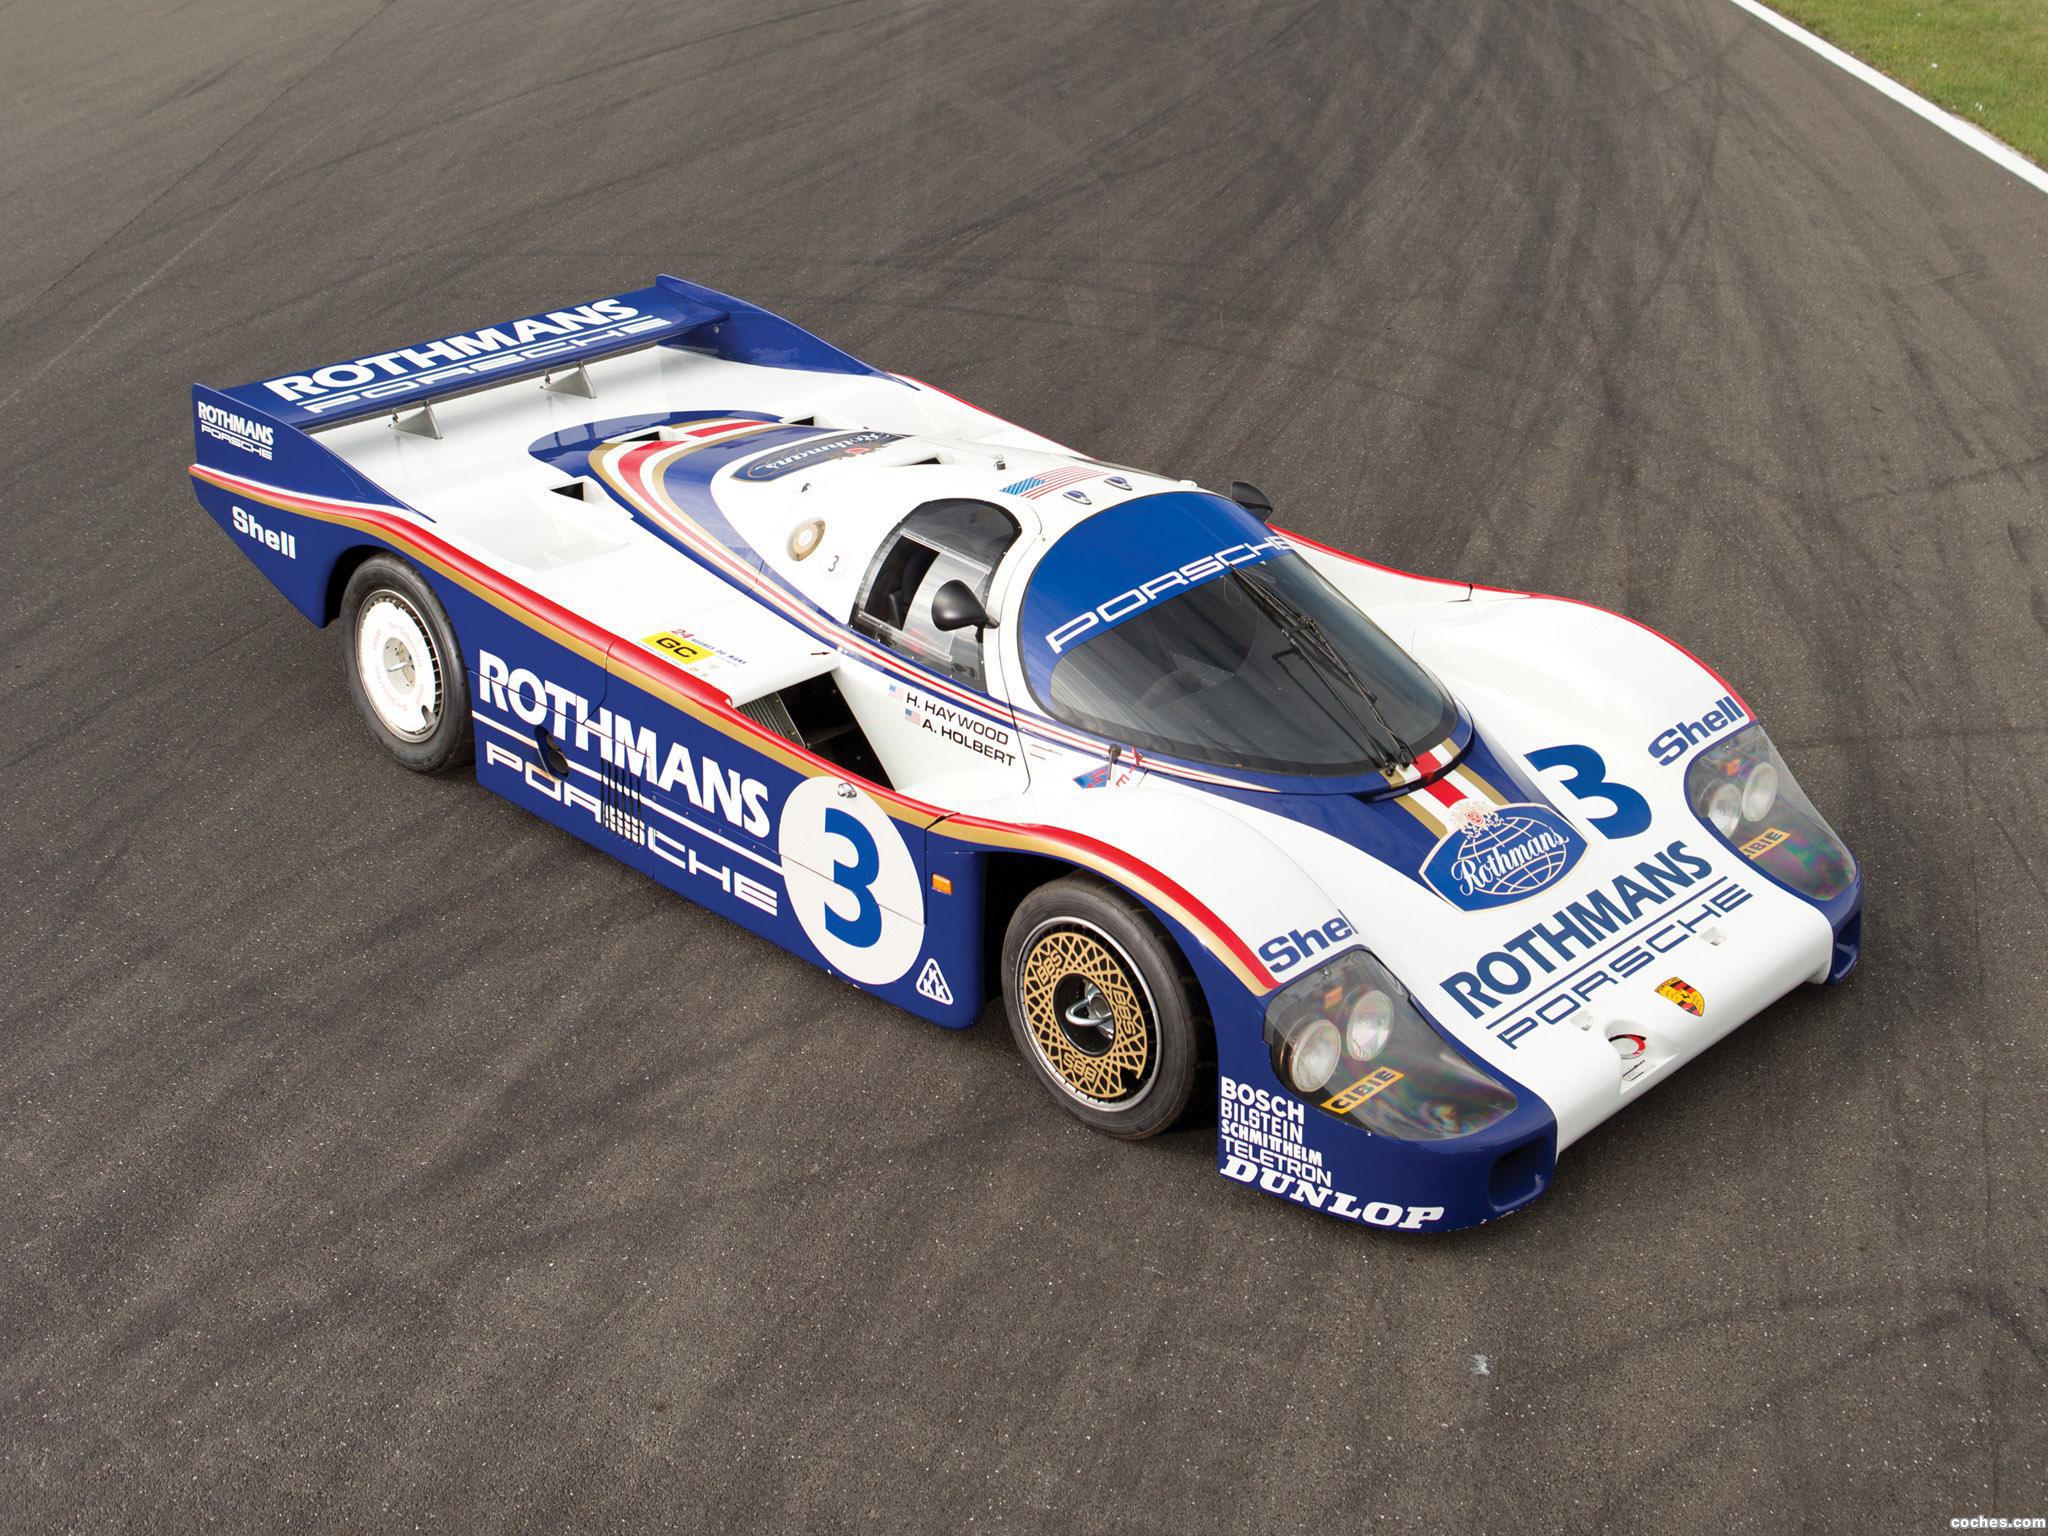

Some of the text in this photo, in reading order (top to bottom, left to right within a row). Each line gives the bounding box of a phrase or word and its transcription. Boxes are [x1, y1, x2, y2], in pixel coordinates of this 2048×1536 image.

[263, 299, 639, 401] ROTHMANS
[305, 317, 672, 414] PORSCHE
[198, 401, 274, 446] ROTHMANS
[201, 424, 273, 461] PORSCHE
[232, 505, 296, 559] Shell
[1044, 535, 1292, 654] PORSCHE
[656, 637, 698, 658] GC
[479, 649, 771, 838] ROTHMANS
[906, 692, 1009, 745] H. HAYWOOD
[922, 719, 1016, 766] A. HOLBERT
[1647, 696, 1745, 766] Shell
[1523, 744, 1652, 841] 3
[486, 742, 778, 916] PORSCHE
[1743, 831, 1783, 857] IBIE
[823, 808, 882, 948] 3
[1451, 828, 1569, 896] Rothmans
[1258, 909, 1358, 973] She
[1438, 840, 1713, 1019] ROTHMANS
[1036, 949, 1066, 986] BBS
[1496, 883, 1754, 1050] PORSCHE
[1112, 987, 1137, 1036] BBS
[1062, 1051, 1097, 1083] BBS
[1330, 1070, 1396, 1109] CIBIE
[1221, 1076, 1305, 1125] BOSCH
[1221, 1098, 1303, 1145] BILSTEIN
[1221, 1134, 1332, 1188] TELETRON
[1219, 1154, 1445, 1230] DUNLOP
